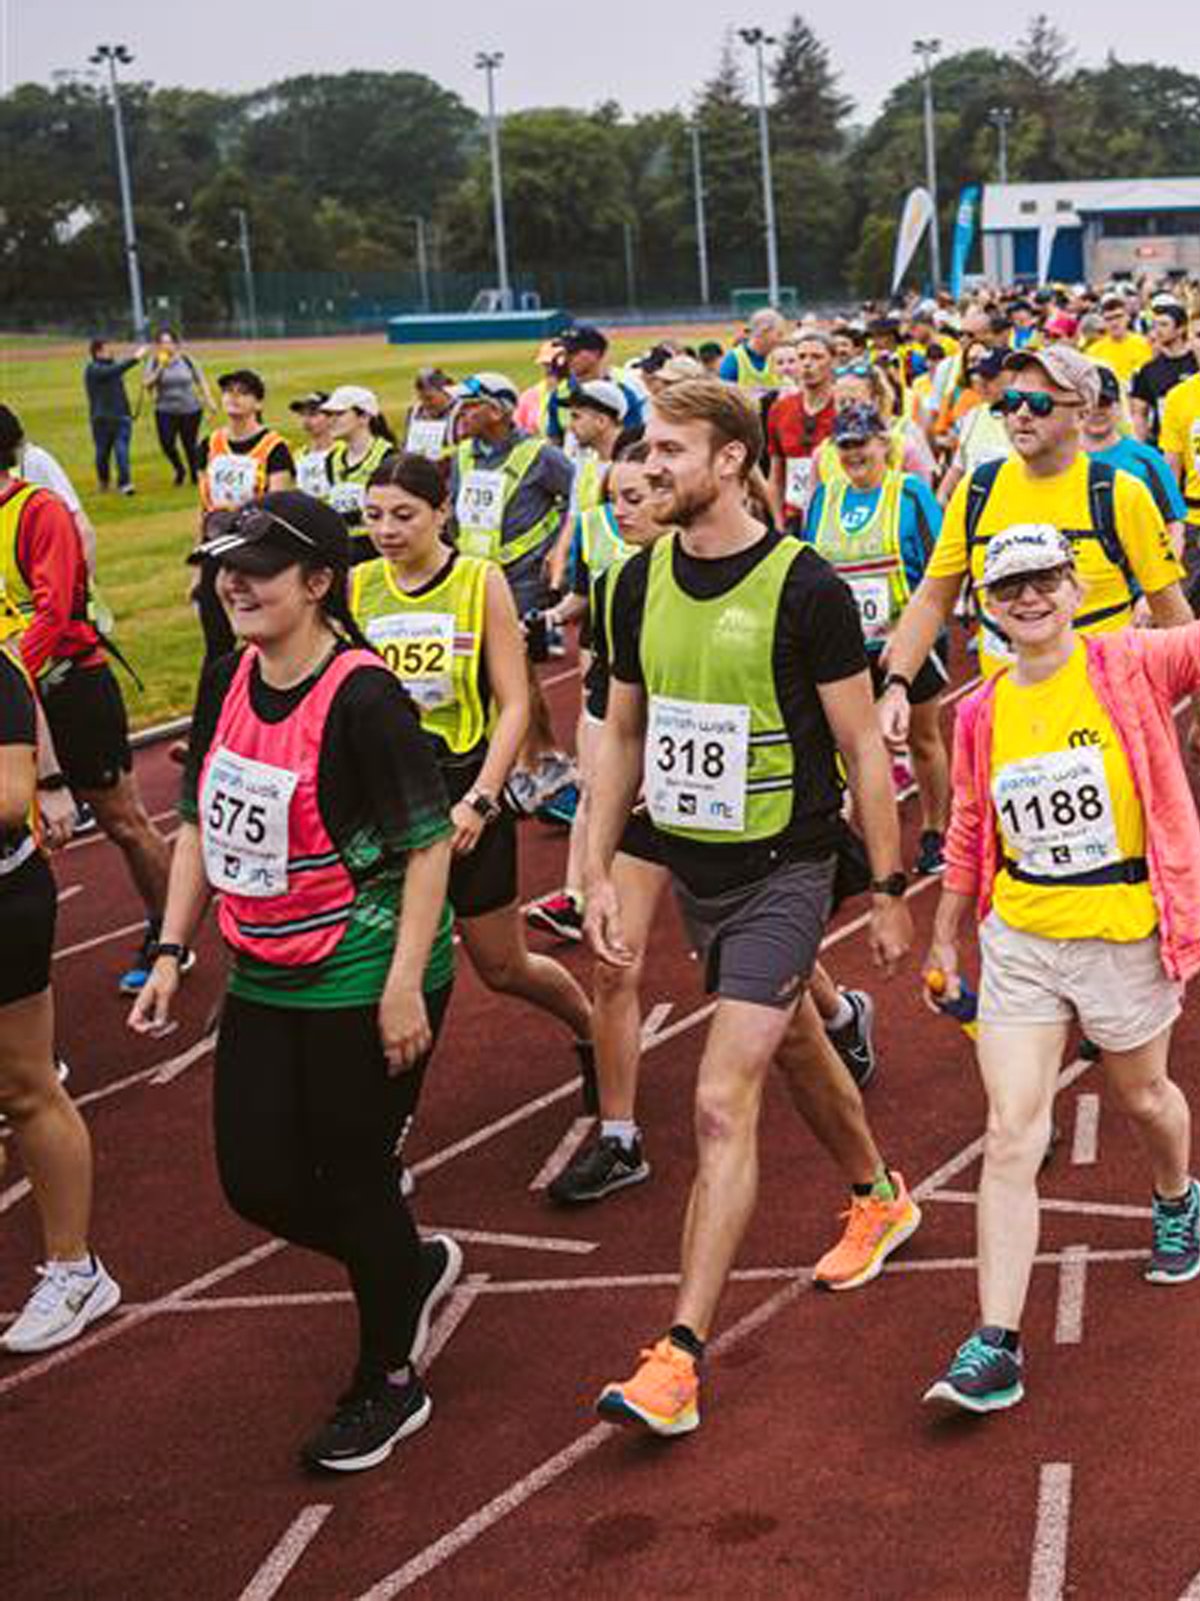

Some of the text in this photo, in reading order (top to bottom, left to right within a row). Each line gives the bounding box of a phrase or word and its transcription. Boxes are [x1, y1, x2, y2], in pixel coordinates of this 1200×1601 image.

[383, 643, 445, 675] 052
[657, 735, 725, 778] 318
[209, 790, 266, 844] 575
[1001, 784, 1104, 833] 1188
